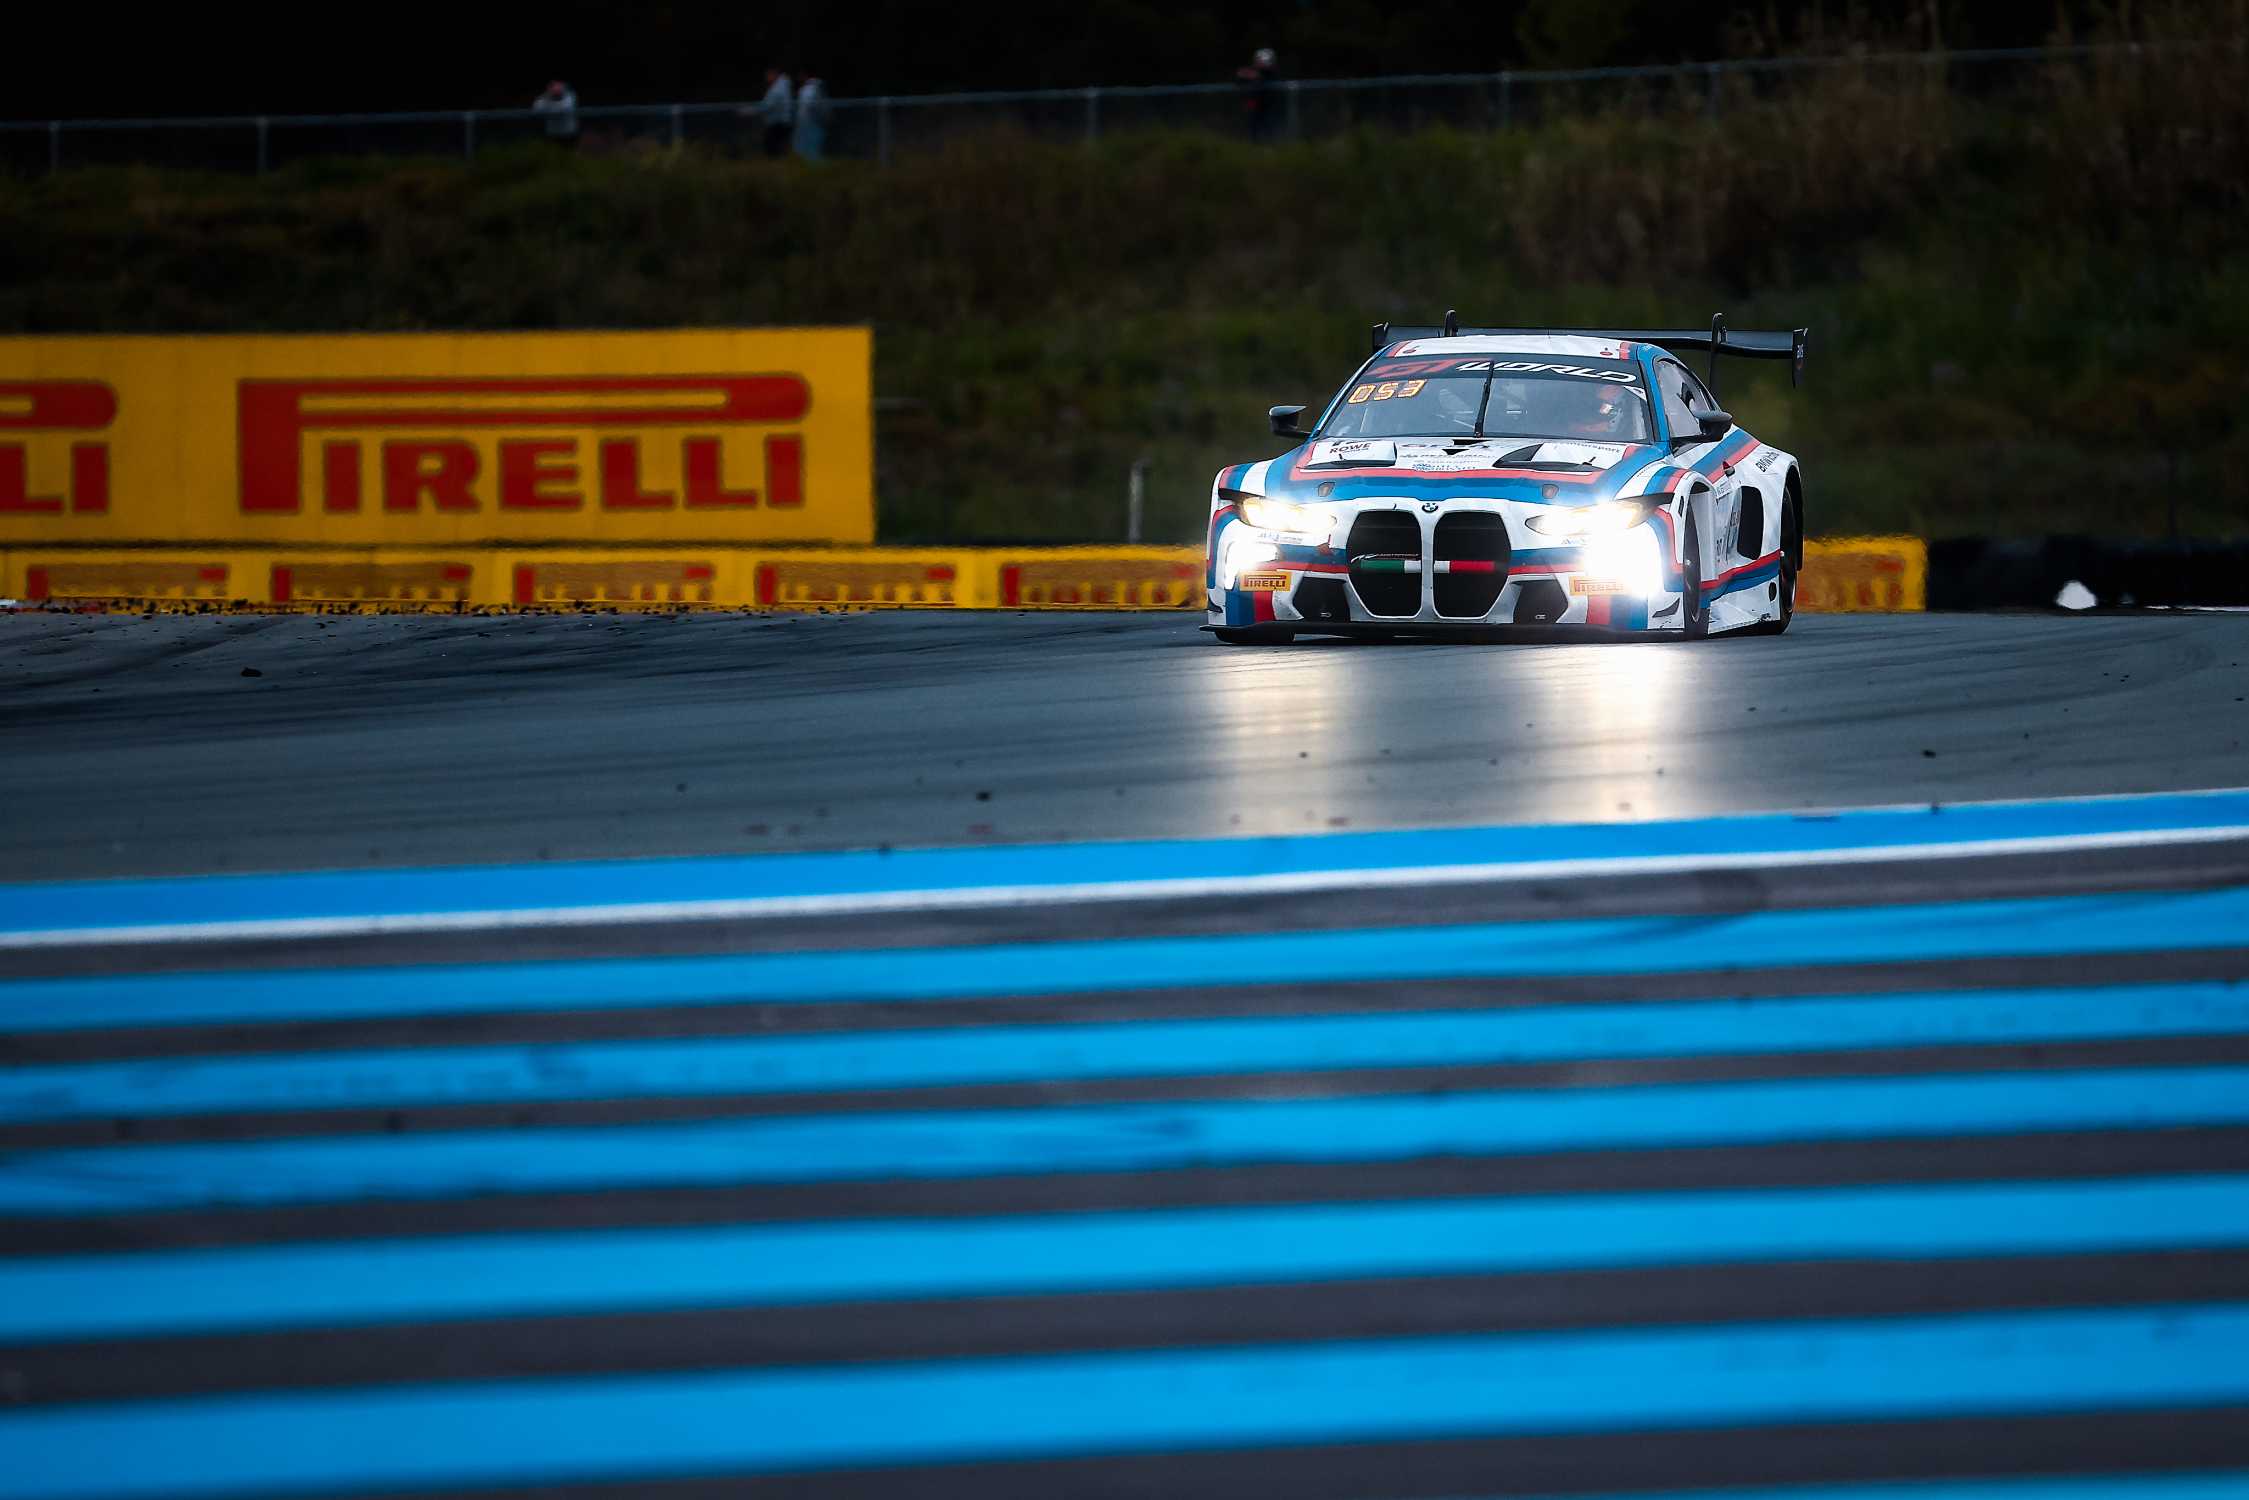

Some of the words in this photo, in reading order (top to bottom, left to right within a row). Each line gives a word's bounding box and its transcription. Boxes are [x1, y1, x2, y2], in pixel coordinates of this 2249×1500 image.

[1455, 361, 1637, 383] WORLD
[1348, 378, 1428, 404] 053
[237, 371, 813, 514] PIRELLI
[1329, 443, 1372, 454] ROWE
[1244, 574, 1287, 588] PIRELLI
